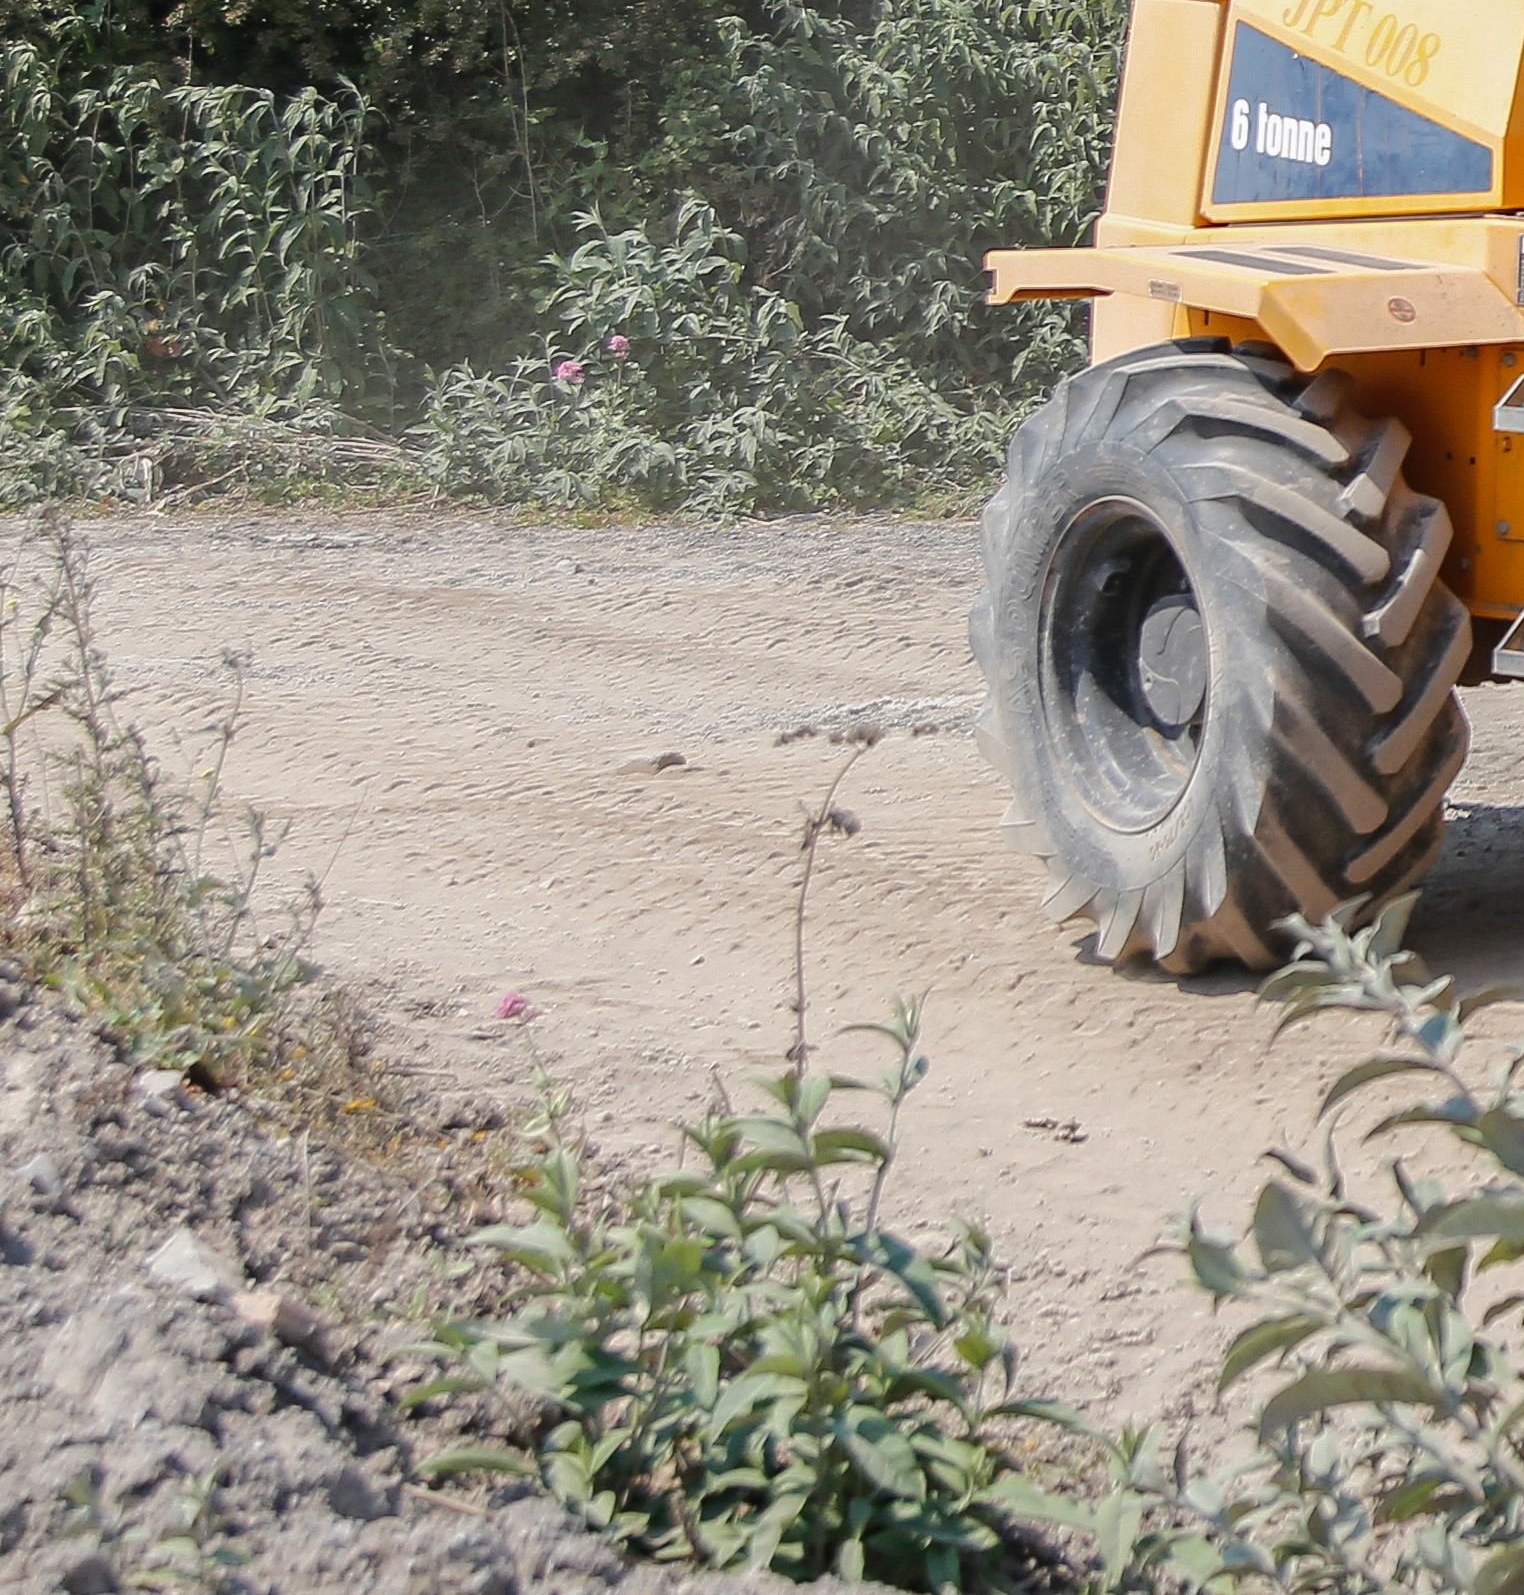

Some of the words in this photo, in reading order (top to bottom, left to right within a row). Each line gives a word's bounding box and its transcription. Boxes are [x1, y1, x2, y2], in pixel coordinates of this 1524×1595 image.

[1366, 13, 1442, 87] 008
[1231, 98, 1250, 150] 6
[1256, 102, 1332, 166] tonne
